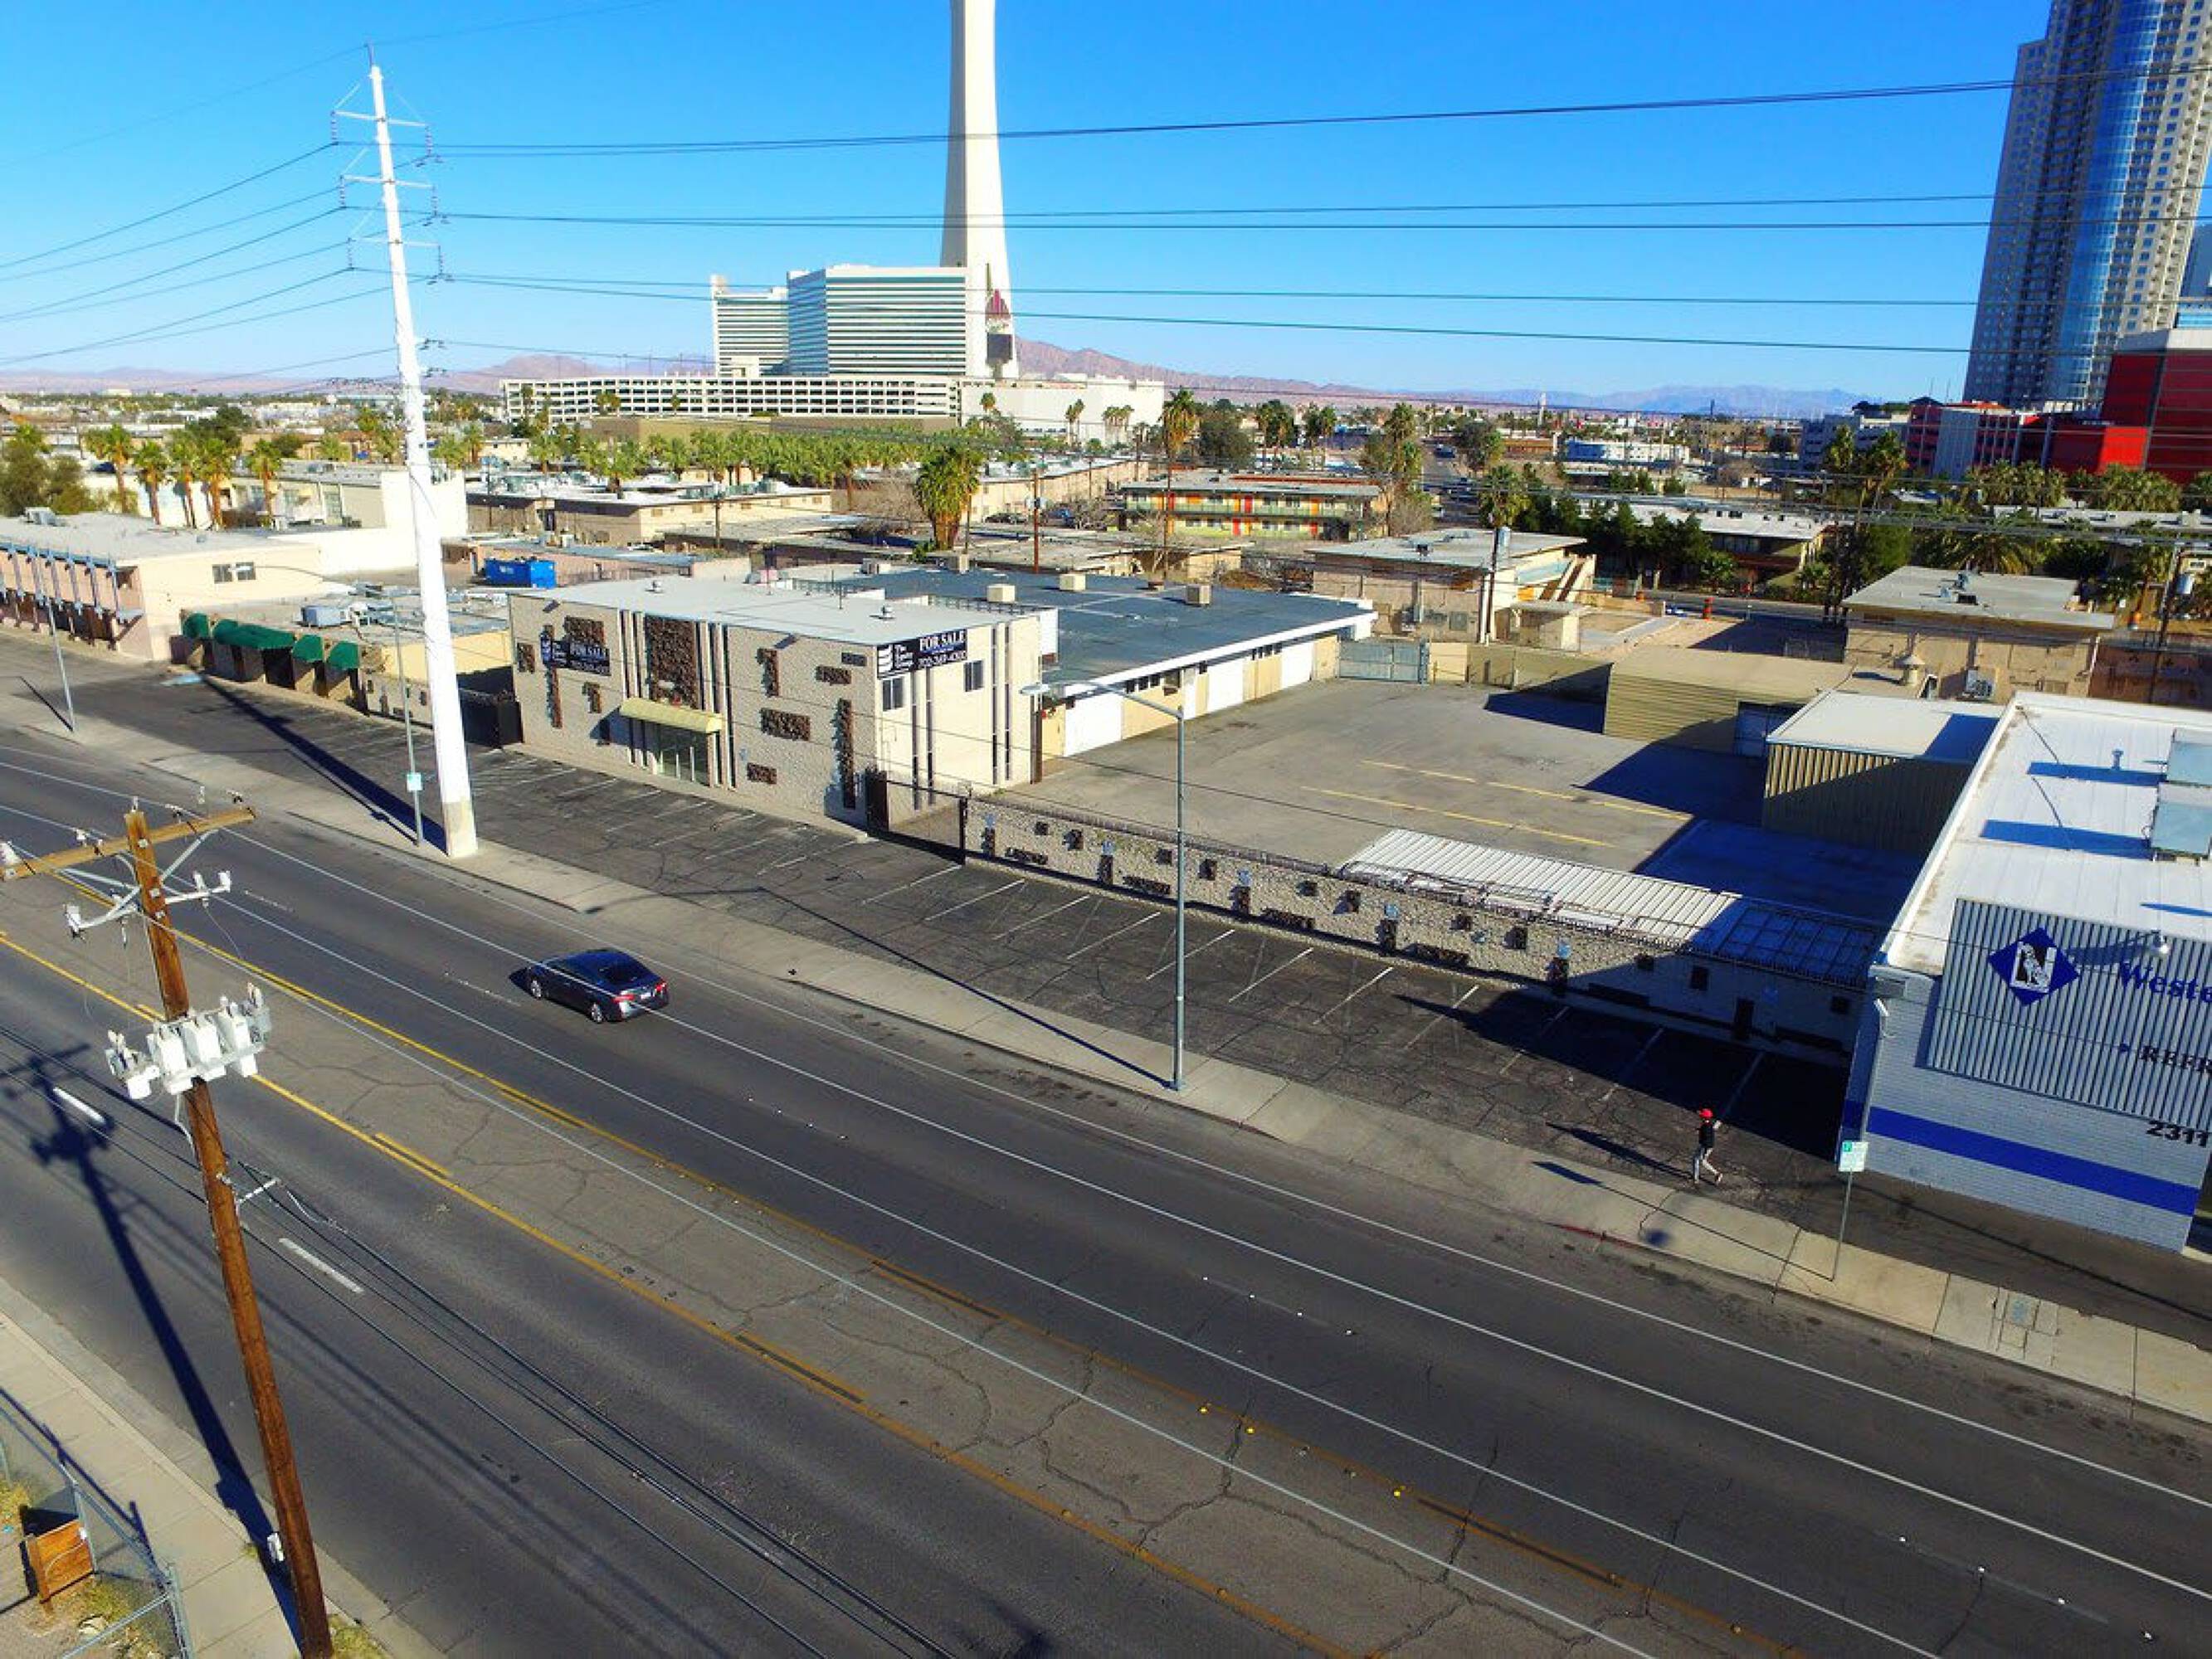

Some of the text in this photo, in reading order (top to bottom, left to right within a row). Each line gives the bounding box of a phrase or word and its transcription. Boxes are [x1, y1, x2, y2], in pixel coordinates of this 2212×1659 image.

[919, 635, 939, 652] FOR
[941, 630, 966, 646] SALE
[2119, 960, 2212, 1004] Weste
[2146, 1119, 2209, 1149] 2311
